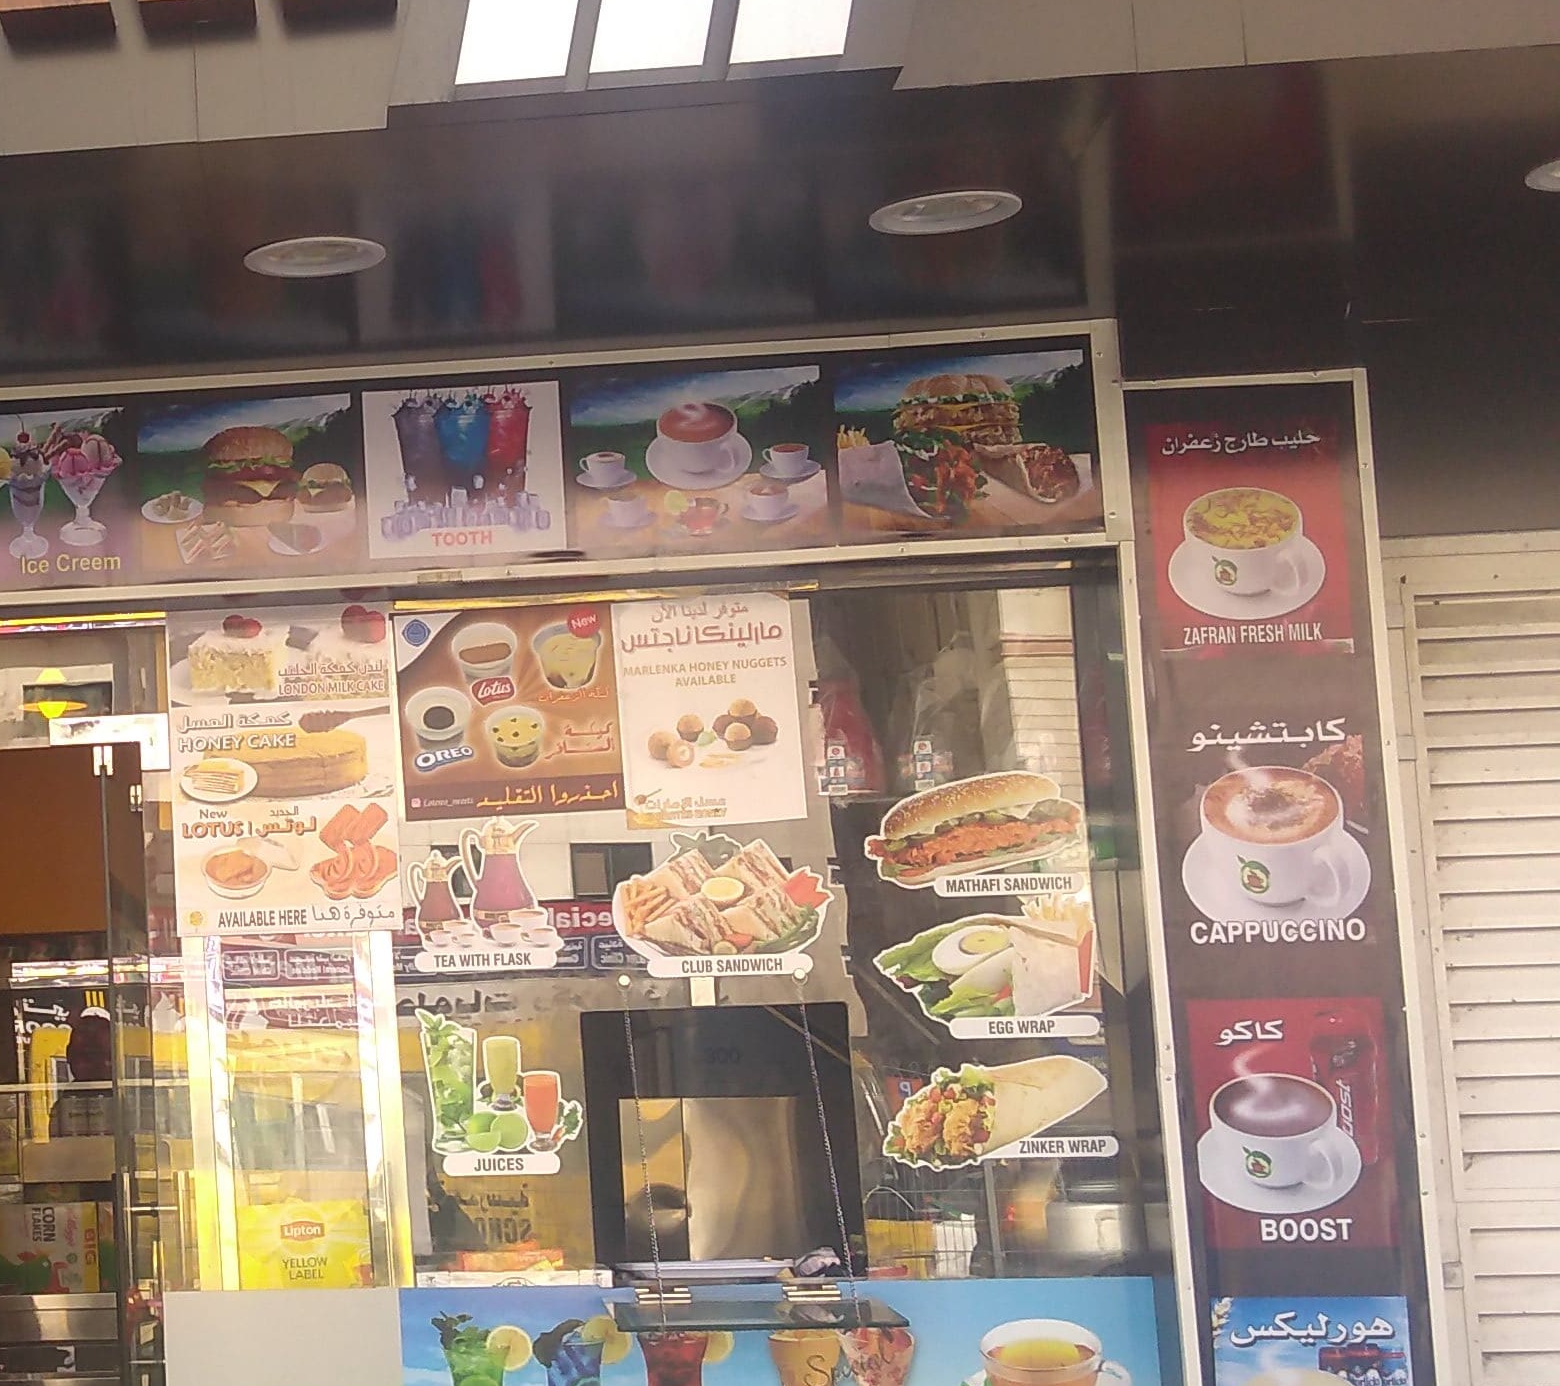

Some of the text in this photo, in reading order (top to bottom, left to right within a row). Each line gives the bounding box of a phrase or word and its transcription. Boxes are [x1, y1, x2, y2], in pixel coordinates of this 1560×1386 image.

[432, 529, 493, 548] TOOTH
[20, 552, 121, 574] Ice Creem
[572, 613, 598, 630] New
[1183, 622, 1322, 646] ZAFRAN FRESH MILK
[623, 656, 788, 676] MARLENKA HONEY NUGGETS
[278, 678, 385, 695] LONDON MILK CAKE
[675, 674, 737, 687] AVAILABLE
[477, 682, 512, 700] Lotus
[177, 732, 297, 754] HONEY CAKE
[416, 746, 473, 769] OREO
[199, 808, 228, 819] New
[182, 820, 244, 839] LOTUS
[945, 875, 1072, 893] MATHAFI SANDWICH
[218, 908, 307, 928] AVAILABLE HERE
[1190, 917, 1366, 944] CAPPUCCINO
[433, 954, 457, 968] TEA
[460, 953, 491, 967] WITH
[494, 951, 532, 967] FLASK
[681, 957, 784, 974] CLUB SANDWICH
[988, 1018, 1056, 1035] EGG WRAP
[1214, 1019, 1285, 1046] كاكو
[1019, 1137, 1107, 1155] ZINKER WRAP
[474, 1156, 525, 1172] JUICES
[31, 1207, 42, 1242] FLAKES
[42, 1206, 56, 1242] CORN
[284, 1223, 322, 1239] Lipton
[1260, 1217, 1352, 1242] BOOST
[281, 1255, 328, 1270] YELLOW
[288, 1268, 325, 1281] LABEL
[1229, 1311, 1395, 1346] هورليكس
